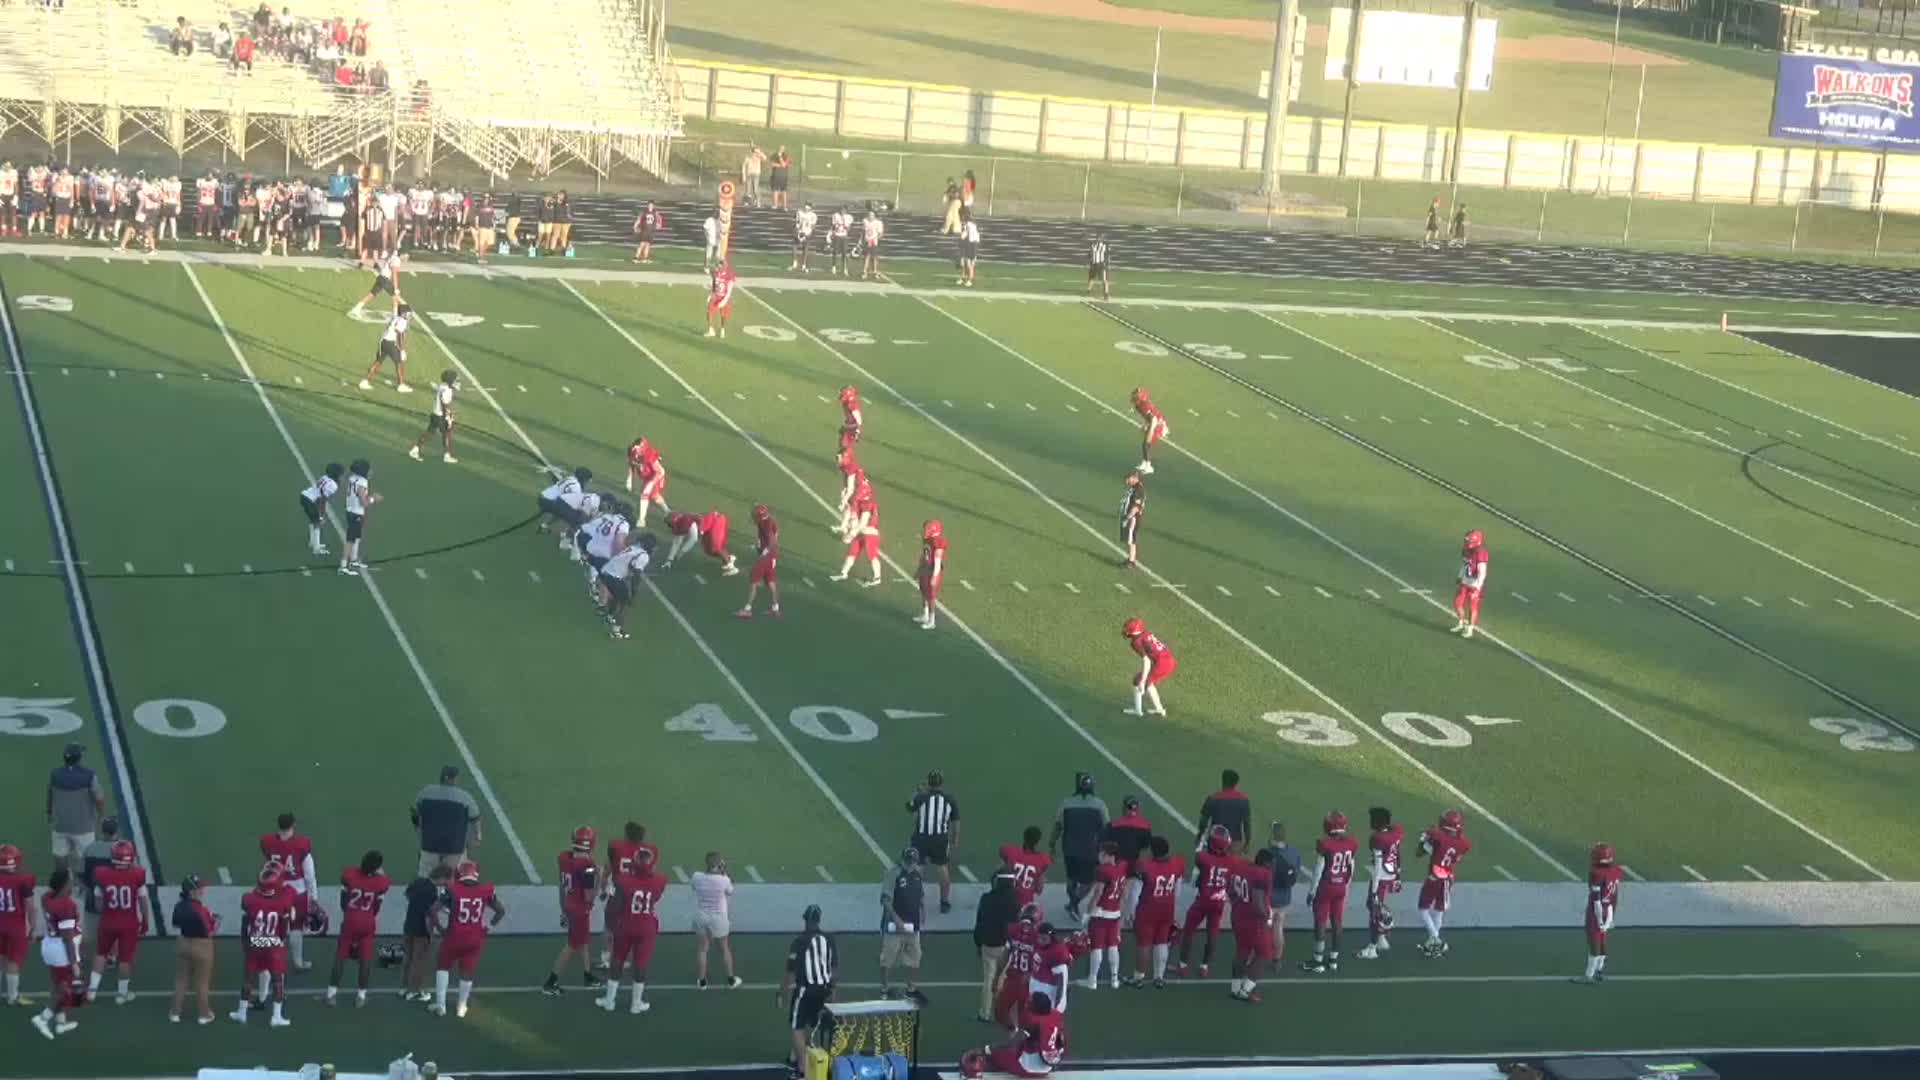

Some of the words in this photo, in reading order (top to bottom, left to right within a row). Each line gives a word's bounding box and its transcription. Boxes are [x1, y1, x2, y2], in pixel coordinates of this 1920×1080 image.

[1818, 111, 1896, 131] HOUMA
[105, 885, 131, 909] 30
[630, 890, 651, 915] 61
[458, 897, 483, 924] 53
